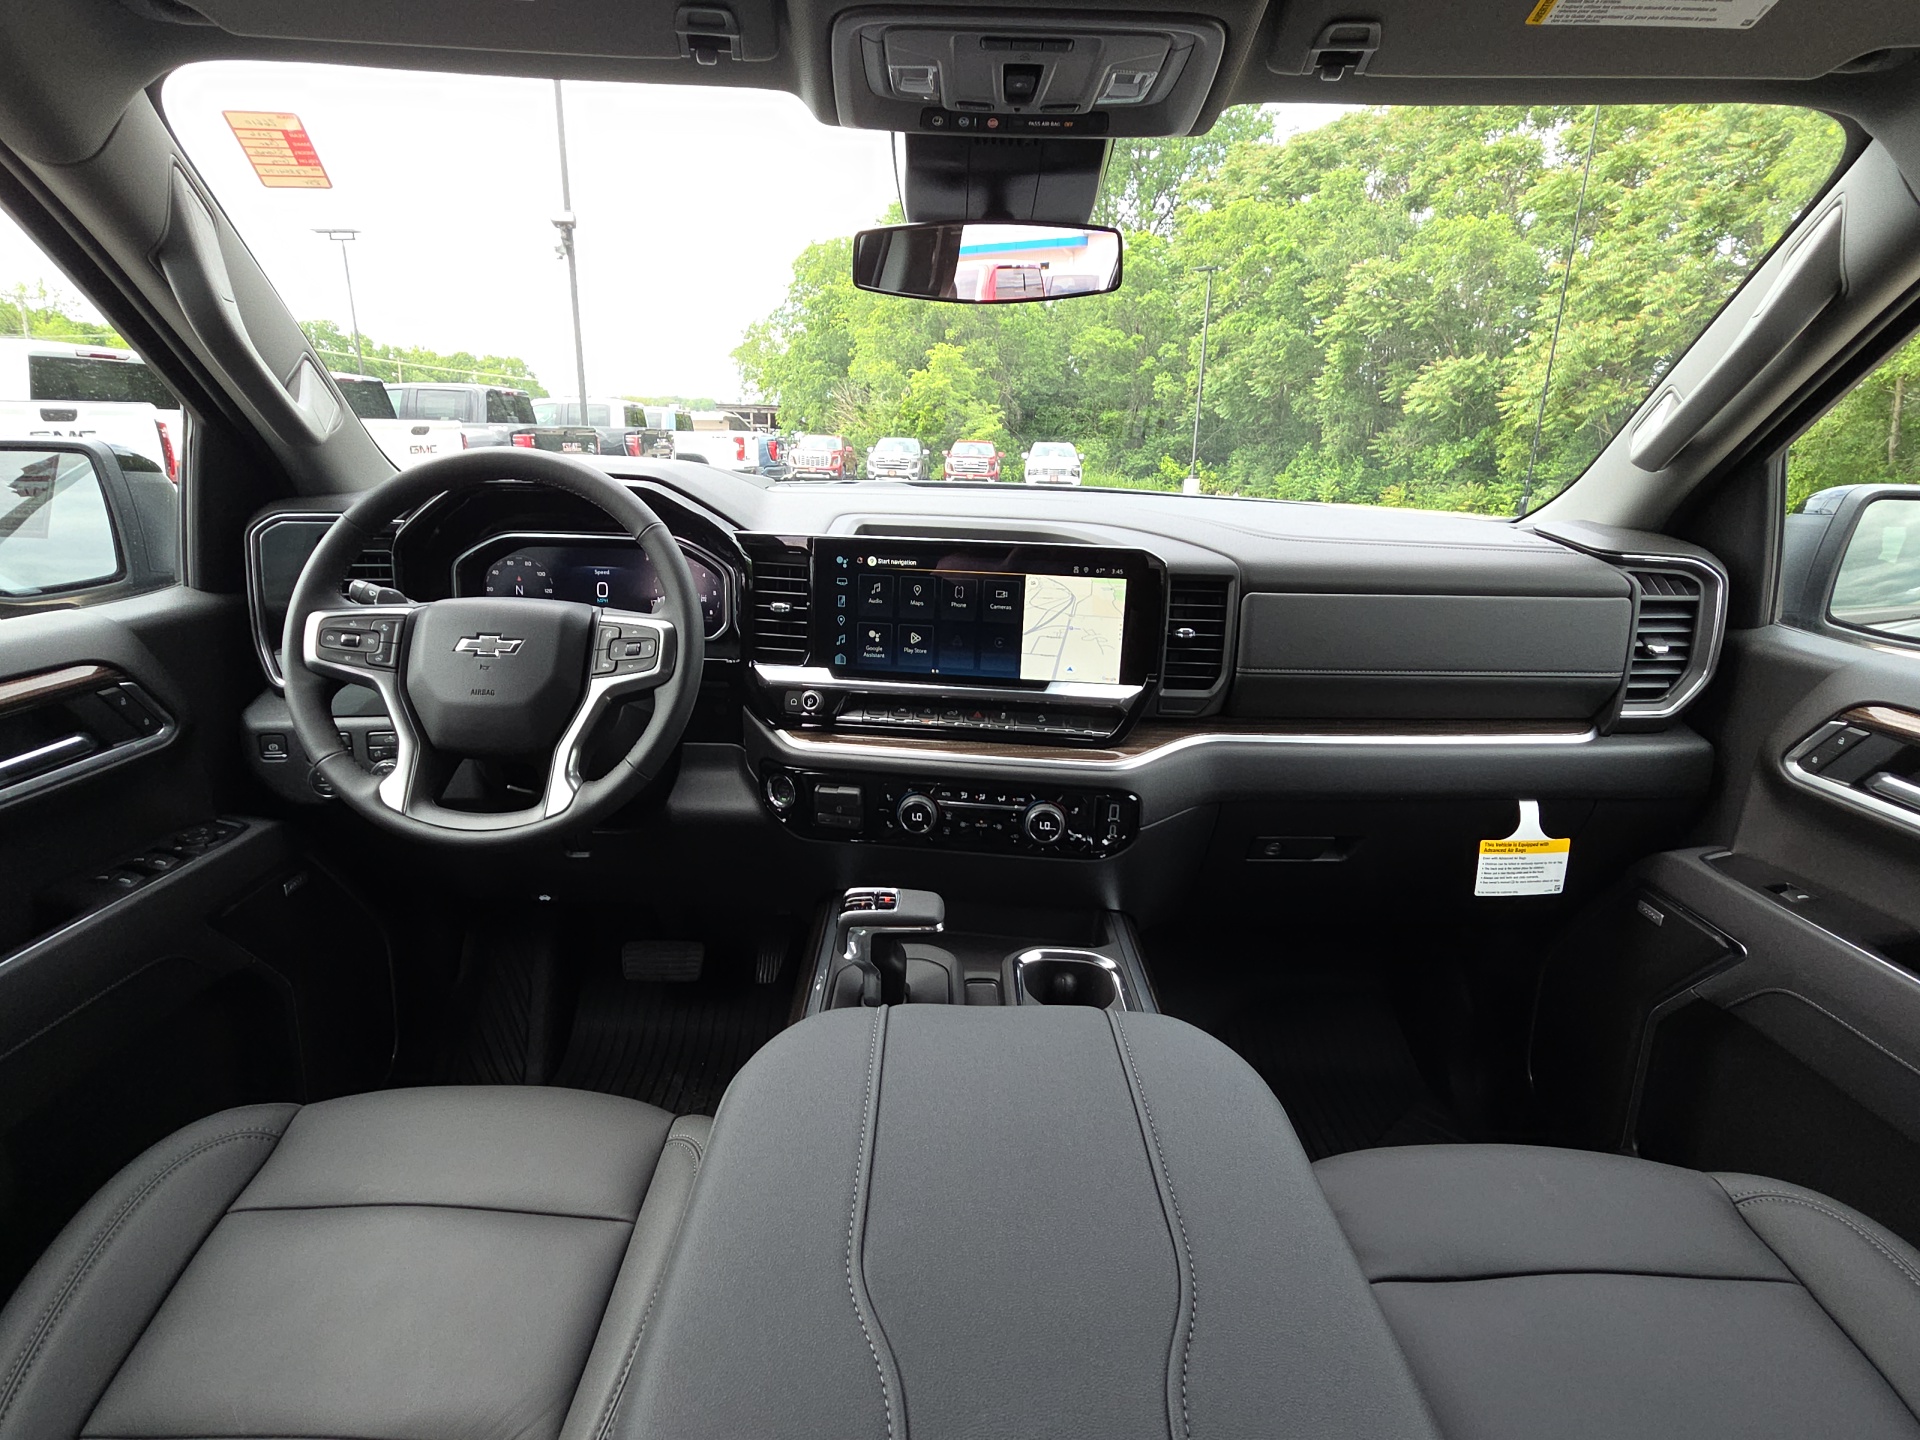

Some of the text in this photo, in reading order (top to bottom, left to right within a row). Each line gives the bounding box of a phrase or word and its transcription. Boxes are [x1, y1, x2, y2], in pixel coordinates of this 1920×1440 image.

[409, 444, 438, 454] GMC
[515, 584, 524, 596] N
[596, 581, 609, 598] 0
[989, 603, 1012, 611] Cameras
[903, 647, 914, 655] Play
